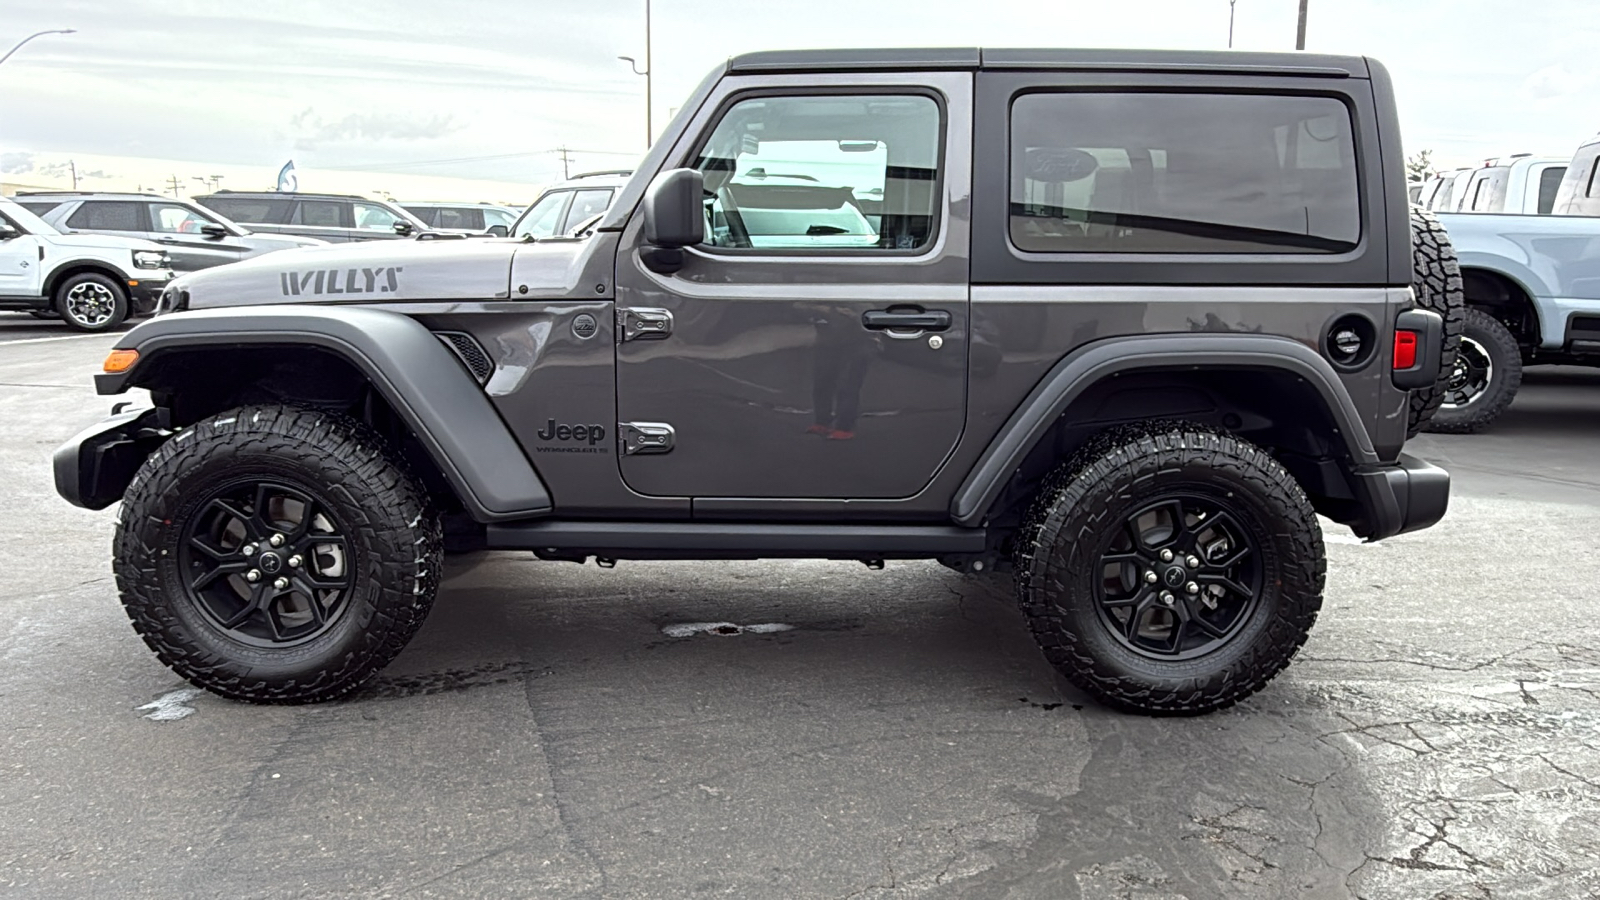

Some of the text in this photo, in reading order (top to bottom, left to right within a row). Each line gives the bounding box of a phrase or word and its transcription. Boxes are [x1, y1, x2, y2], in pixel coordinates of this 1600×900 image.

[1033, 152, 1082, 174] Ford
[280, 266, 403, 296] WILLYS
[537, 417, 606, 446] Jeep
